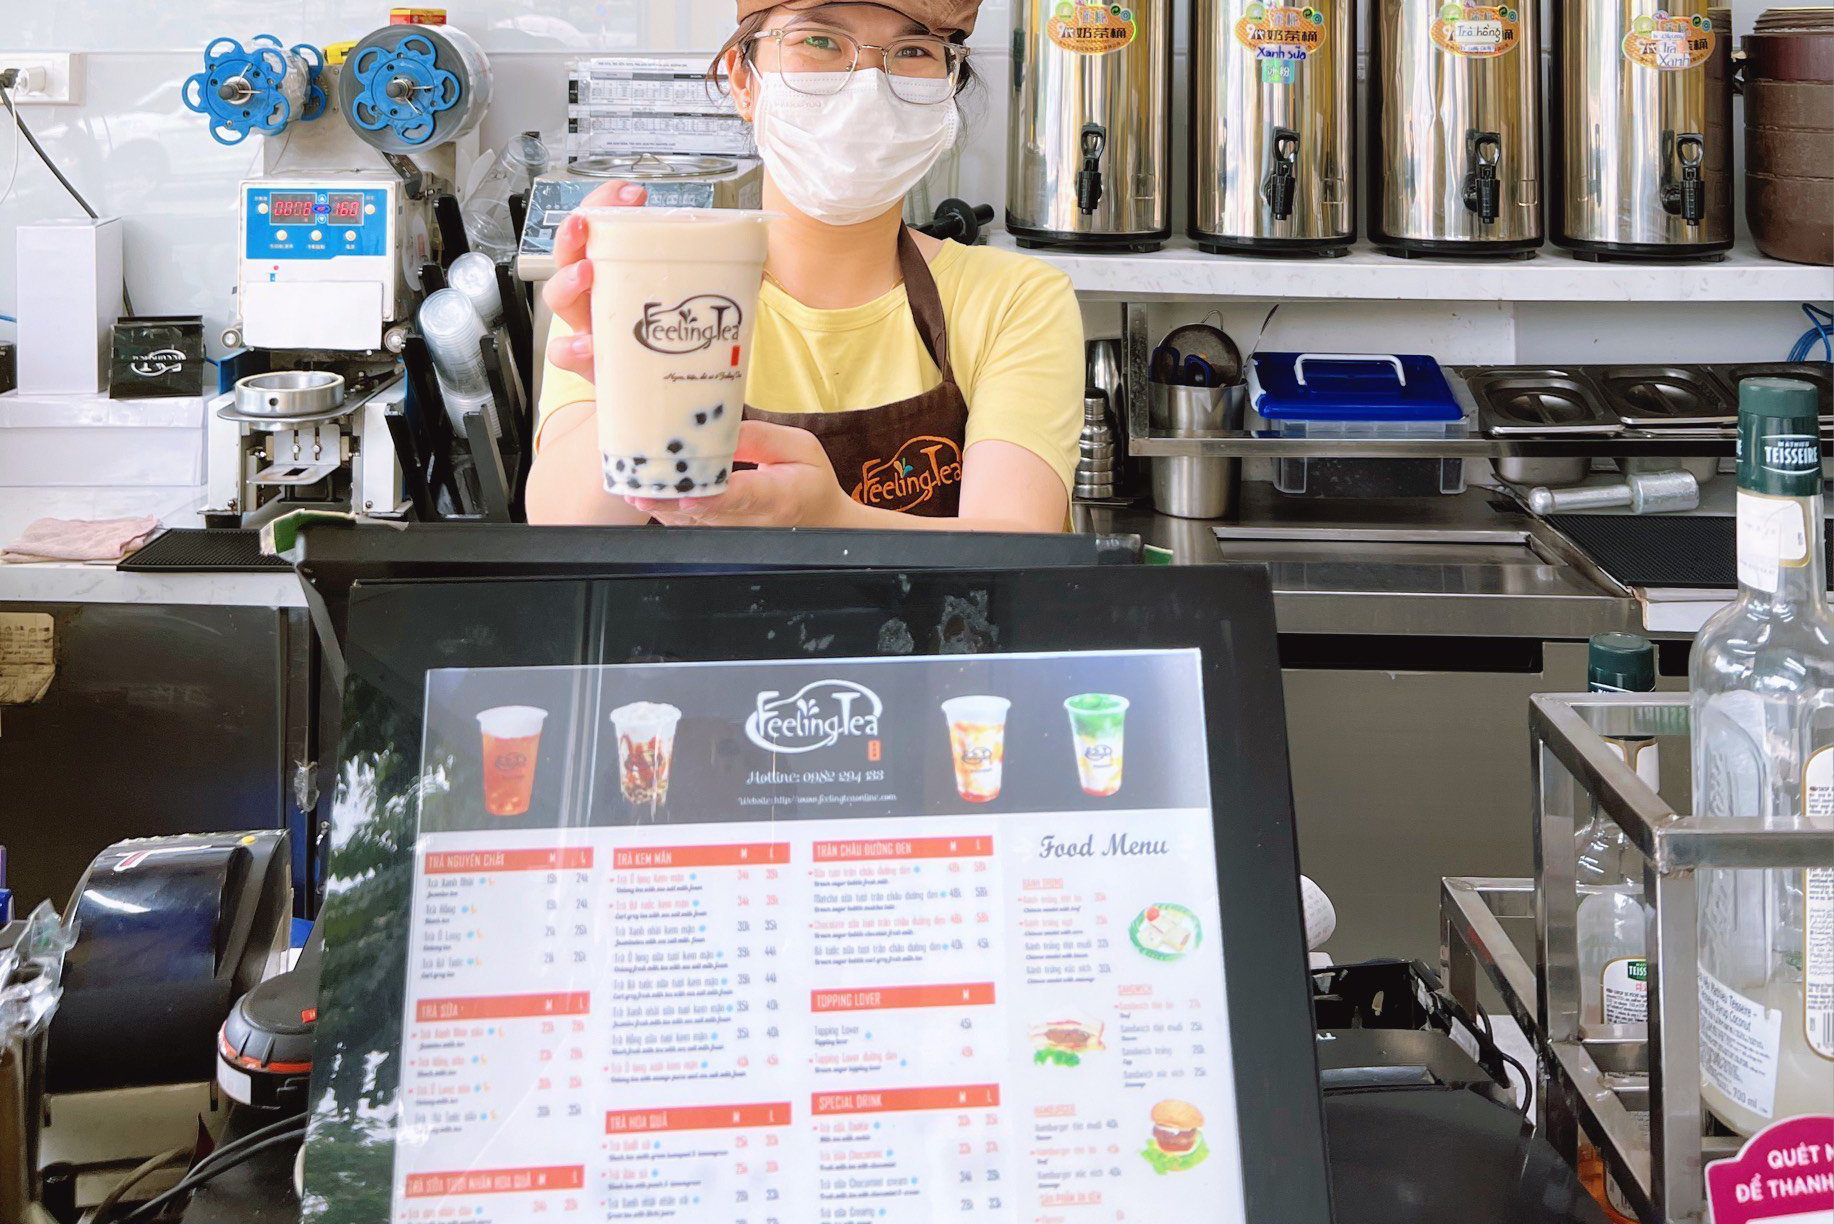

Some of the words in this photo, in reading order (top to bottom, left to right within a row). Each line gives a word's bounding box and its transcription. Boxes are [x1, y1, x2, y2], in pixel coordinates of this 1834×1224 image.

[1257, 44, 1285, 59] Xanh
[1764, 446, 1819, 465] TEISSEIRE
[1039, 834, 1094, 858] Food
[1102, 833, 1169, 856] Menu
[636, 853, 651, 865] KEM
[817, 994, 851, 1007] TOPPING
[855, 992, 880, 1006] LOVER
[819, 1095, 853, 1110] SPECIAL
[856, 1094, 882, 1107] DRINK
